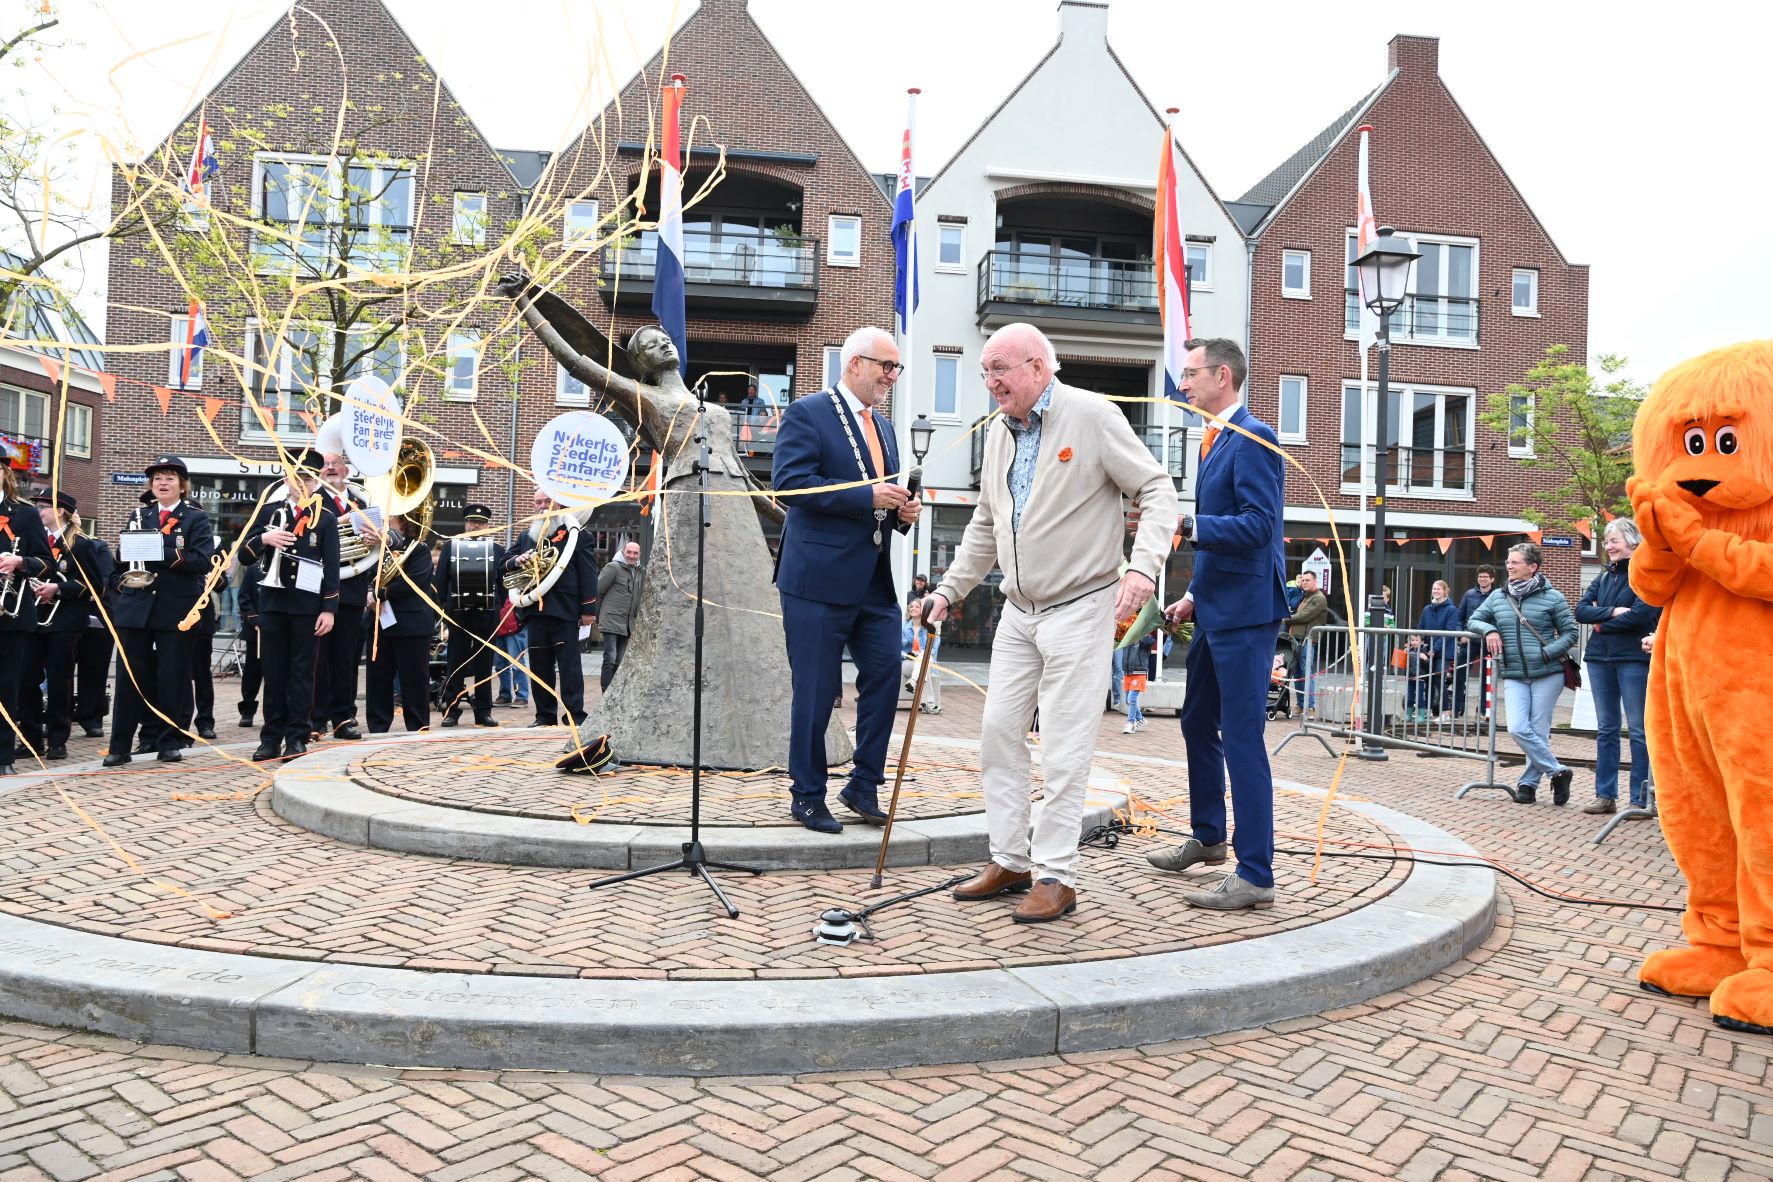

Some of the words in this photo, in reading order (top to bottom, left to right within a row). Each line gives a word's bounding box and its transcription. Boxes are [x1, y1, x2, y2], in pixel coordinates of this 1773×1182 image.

[353, 423, 394, 439] Fanares
[353, 435, 380, 451] Cors
[553, 430, 618, 453] Nijkerks
[191, 490, 221, 499] UDIO
